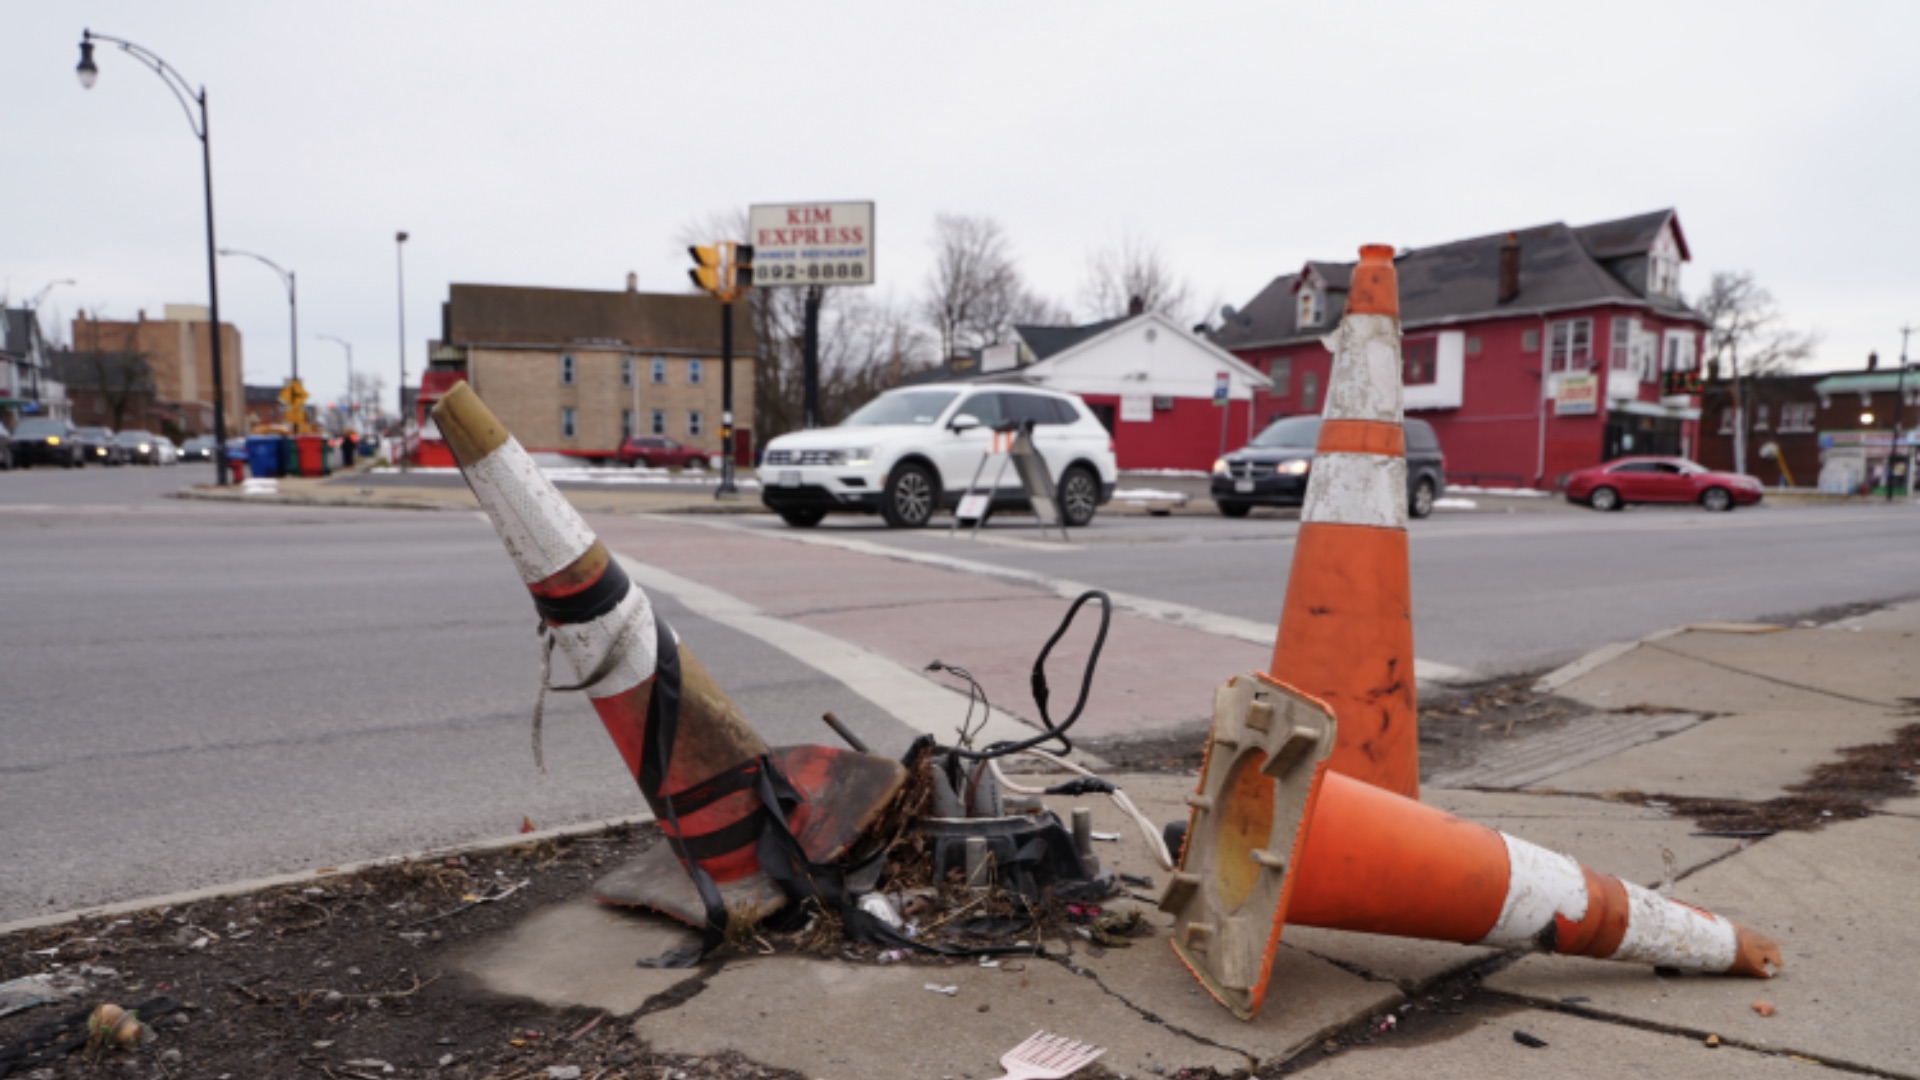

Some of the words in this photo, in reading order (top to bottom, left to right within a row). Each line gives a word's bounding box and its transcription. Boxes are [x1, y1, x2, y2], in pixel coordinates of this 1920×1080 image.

[786, 208, 832, 224] KIM
[758, 226, 864, 246] EXPRESS
[756, 263, 863, 279] 892-8888
